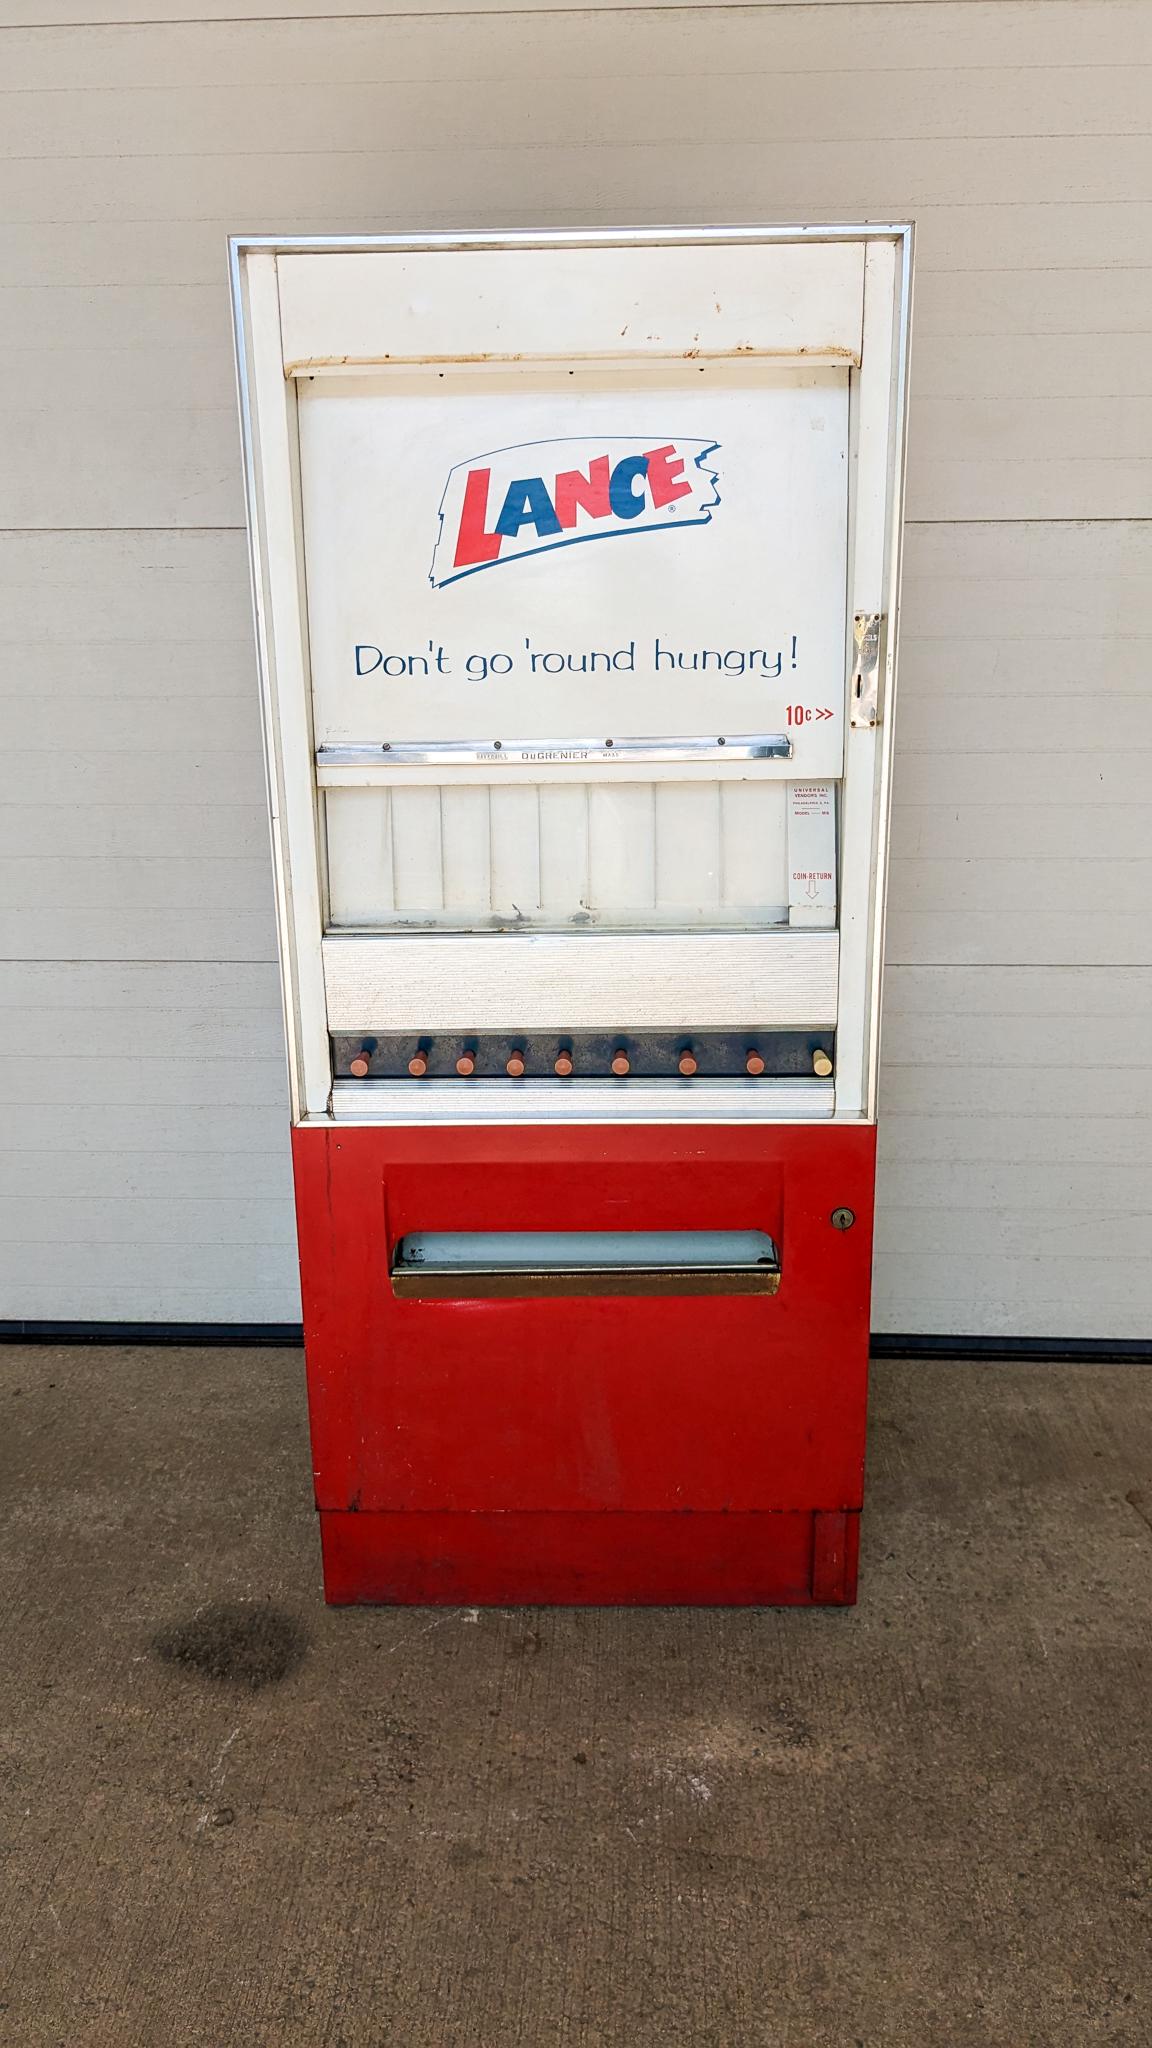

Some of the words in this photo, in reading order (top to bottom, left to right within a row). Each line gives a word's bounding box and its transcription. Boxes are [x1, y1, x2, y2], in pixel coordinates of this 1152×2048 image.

[453, 444, 692, 567] LANCE
[355, 640, 452, 676] Don't
[465, 653, 514, 682] go
[525, 637, 635, 673] 'round
[655, 635, 798, 678] hungry!
